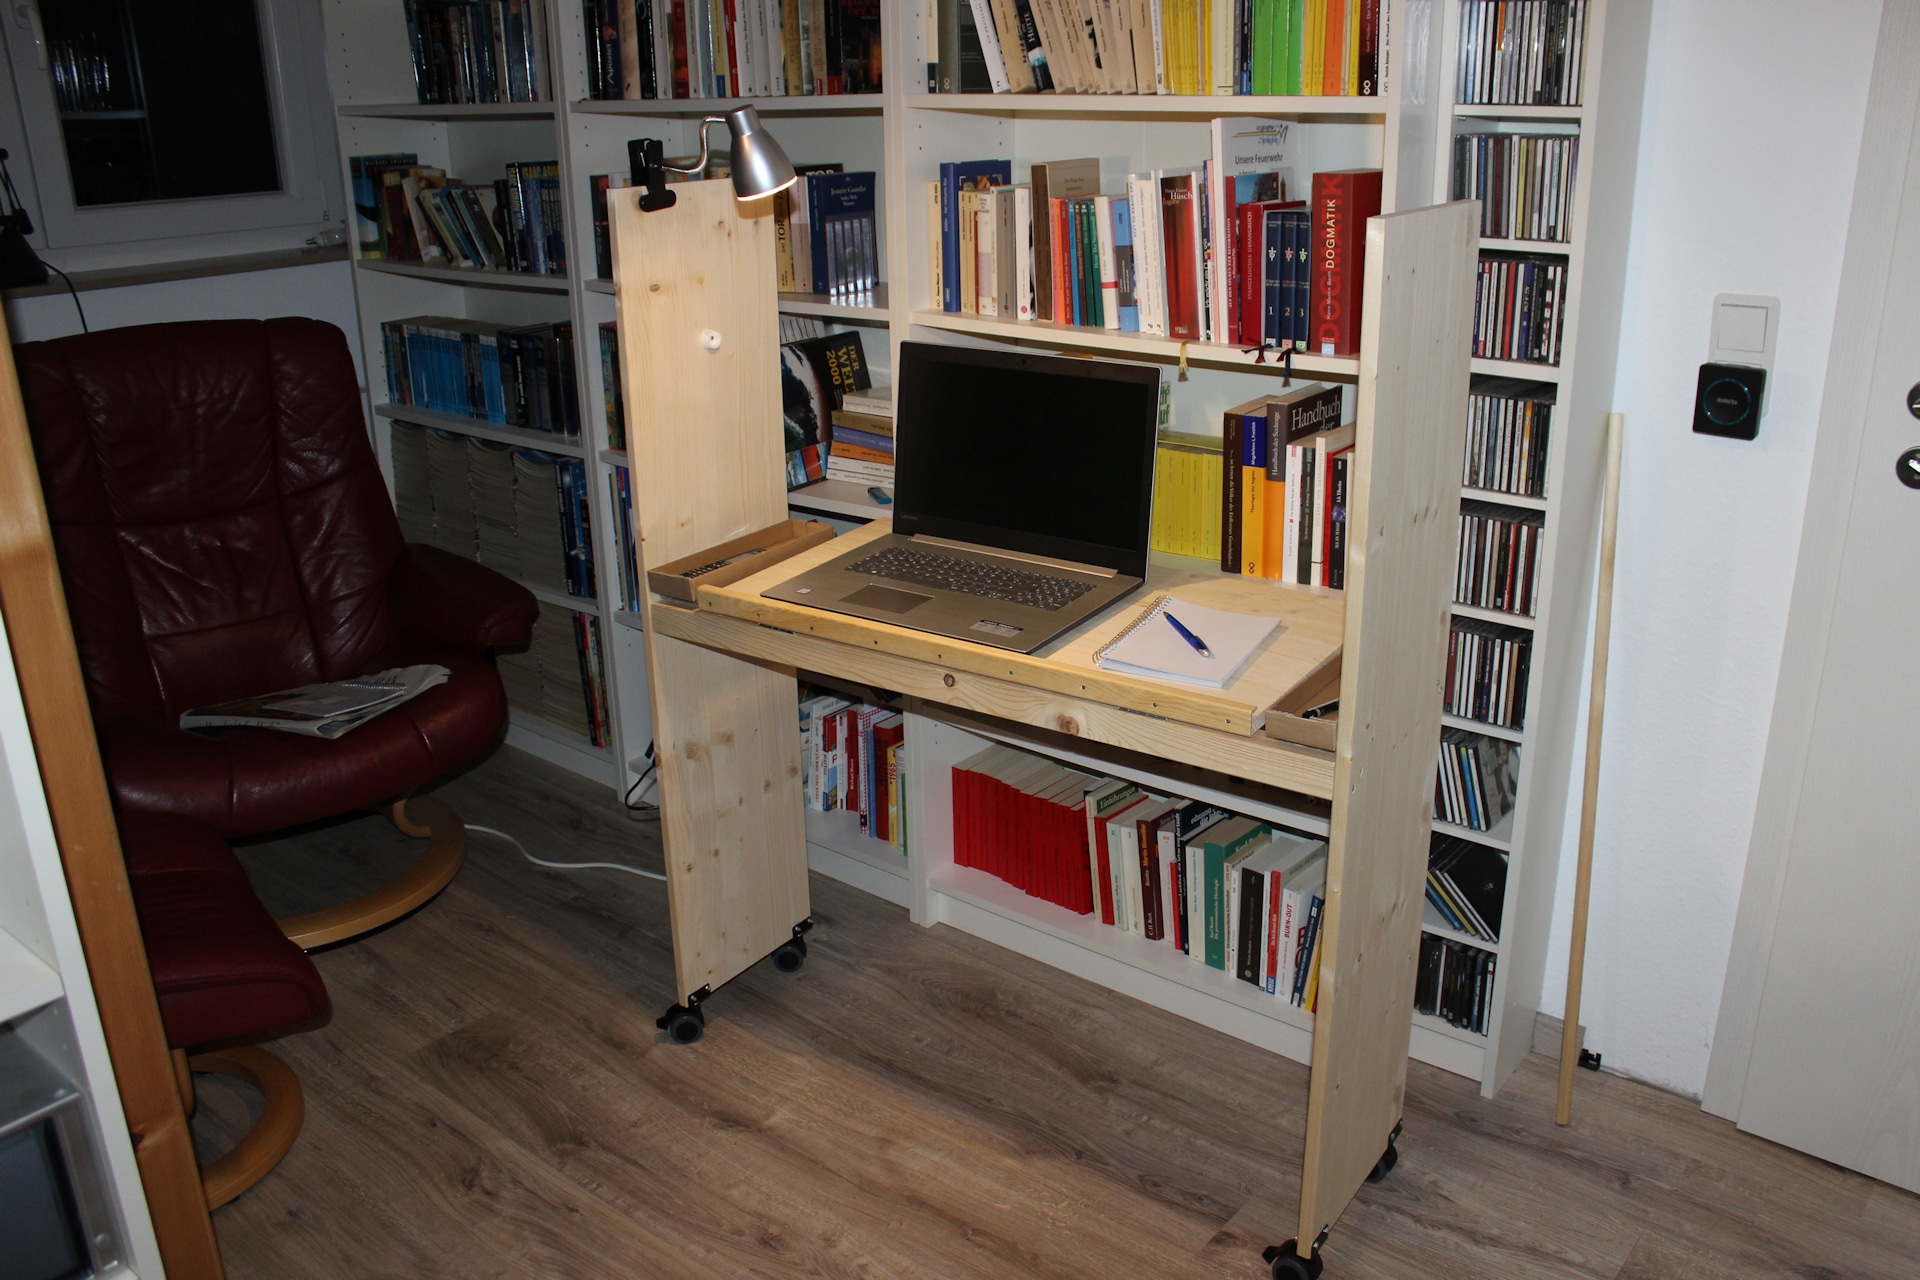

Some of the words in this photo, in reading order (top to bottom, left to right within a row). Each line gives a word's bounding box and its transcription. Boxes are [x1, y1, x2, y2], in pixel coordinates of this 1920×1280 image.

[1024, 11, 1036, 42] HÜTTE
[606, 43, 614, 84] Apostel
[1235, 155, 1254, 165] Unsere
[1254, 152, 1283, 163] Feuerwehr
[1170, 191, 1193, 200] Hüsch
[777, 219, 786, 241] TOR
[1325, 199, 1336, 269] DOGMATIK
[1268, 306, 1273, 315] 1
[1284, 307, 1290, 316] 2
[825, 349, 842, 385] 2000
[848, 344, 860, 372] DER
[1272, 411, 1280, 437] Seelsorge
[1290, 395, 1341, 431] Handbuch
[1098, 786, 1136, 809] Einführungen
[1284, 903, 1293, 939] BURN-OUT
[1267, 977, 1275, 993] KREUZ
